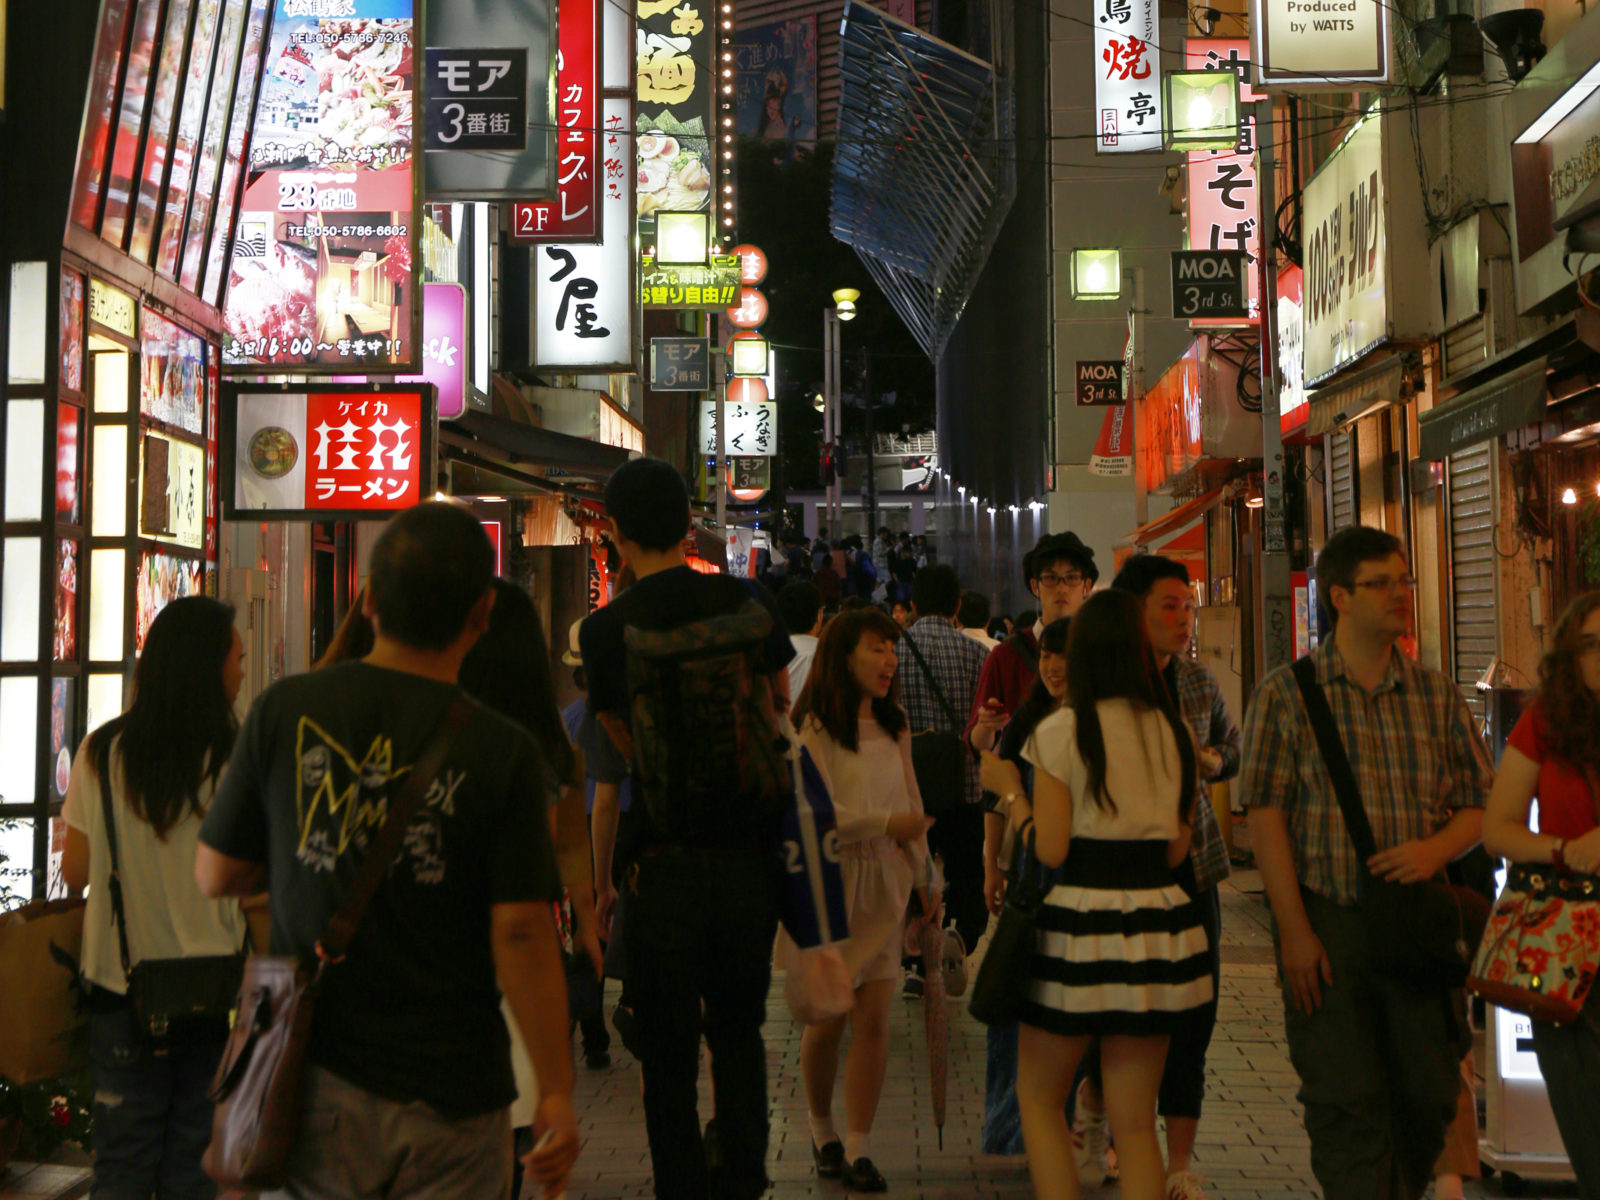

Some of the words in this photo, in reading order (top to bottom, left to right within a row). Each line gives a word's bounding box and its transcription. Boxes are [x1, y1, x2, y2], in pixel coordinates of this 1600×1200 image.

[1286, 0, 1357, 13] Produced
[1290, 21, 1307, 33] by
[1313, 19, 1354, 32] WATTS
[437, 60, 511, 92] モア
[437, 103, 511, 143] 3番街
[558, 83, 589, 222] カフェグレ
[603, 114, 625, 200] 立ち飲み
[280, 185, 355, 208] 23番地
[521, 207, 549, 232] 2F
[1178, 258, 1234, 279] MOA
[1182, 287, 1214, 314] 3rd
[1220, 292, 1235, 307] St.
[664, 343, 701, 360] モア
[1080, 365, 1118, 380] MOA
[1082, 384, 1103, 403] 3rd
[338, 401, 389, 416] ケイカ
[315, 477, 409, 500] ラーメン
